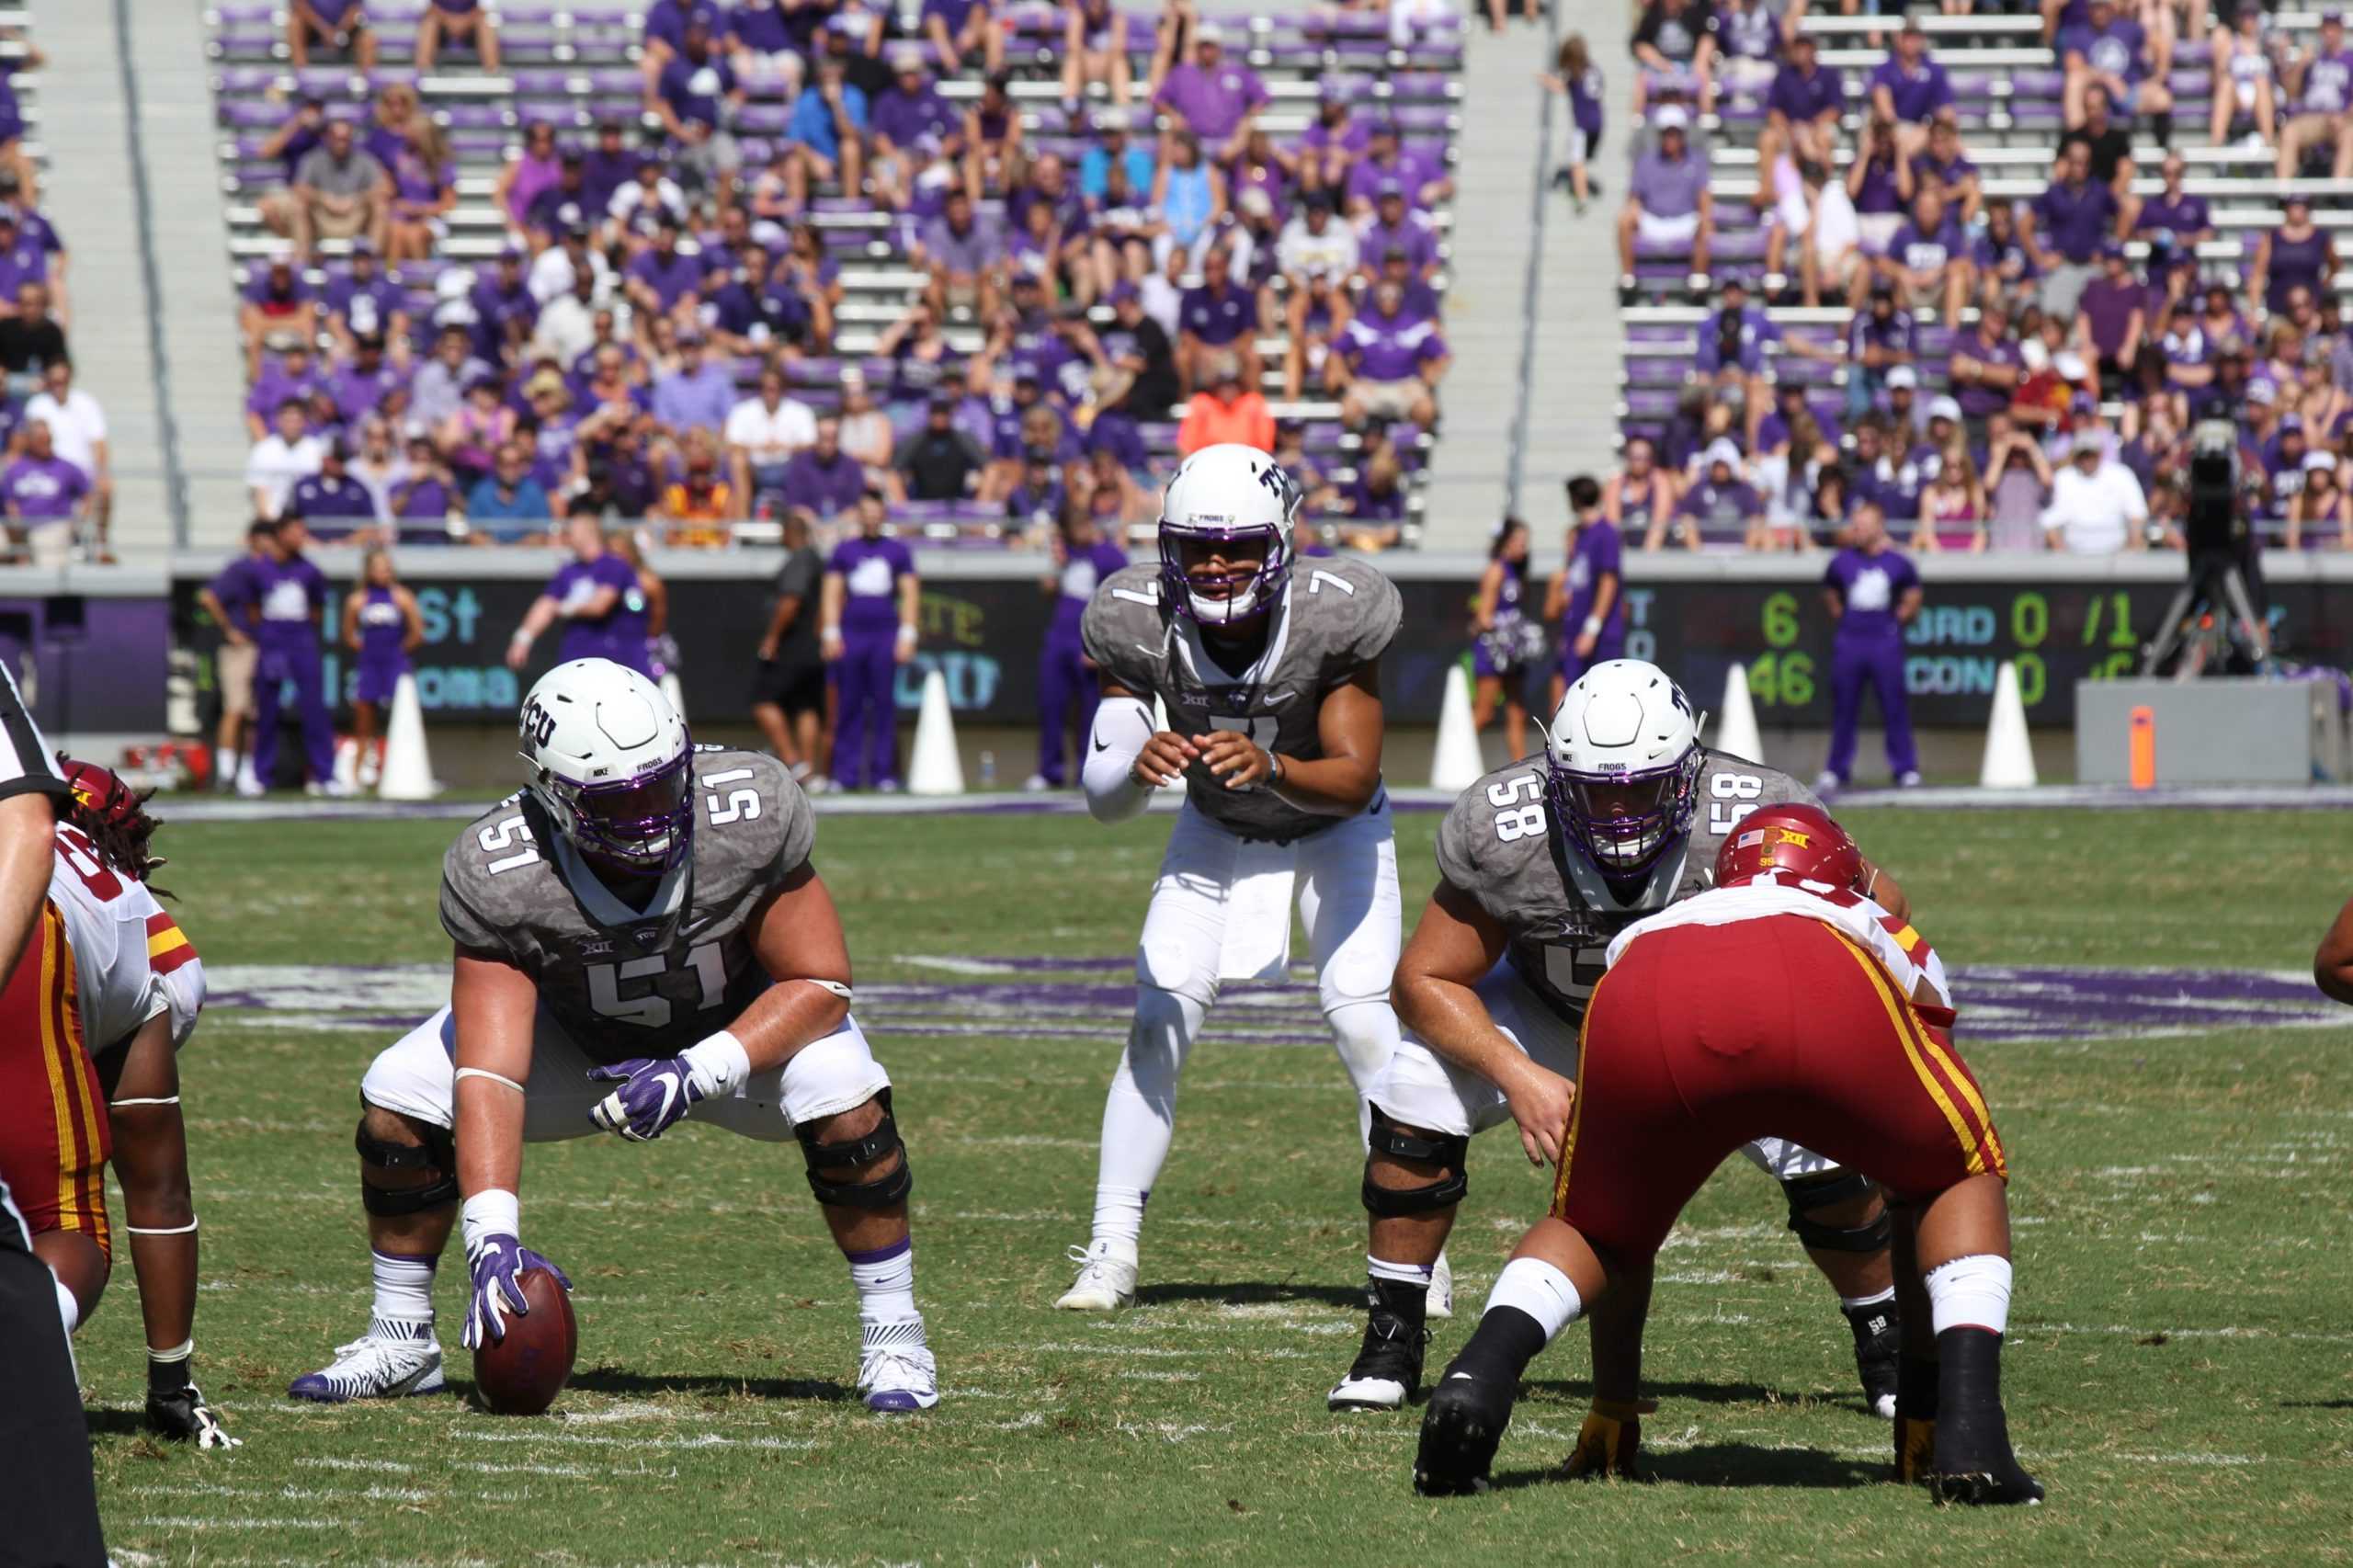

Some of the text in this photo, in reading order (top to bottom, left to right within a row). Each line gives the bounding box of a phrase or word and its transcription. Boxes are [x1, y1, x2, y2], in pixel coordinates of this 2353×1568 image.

[1110, 581, 1159, 607] 7
[1308, 570, 1356, 597] 7
[1762, 592, 1800, 647] 6
[1747, 651, 1816, 707] 46
[1905, 656, 1995, 694] CON
[593, 767, 609, 777] NIKE
[636, 756, 663, 773] FROGS
[1597, 763, 1628, 771] FROGS
[701, 767, 763, 826] 51
[1486, 774, 1548, 844] 58
[1709, 772, 1764, 835] 58
[477, 814, 541, 876] 51
[1759, 858, 1775, 867] 99
[1779, 829, 1810, 850] XII
[586, 941, 728, 1029] 51
[1544, 944, 1608, 1000] 5
